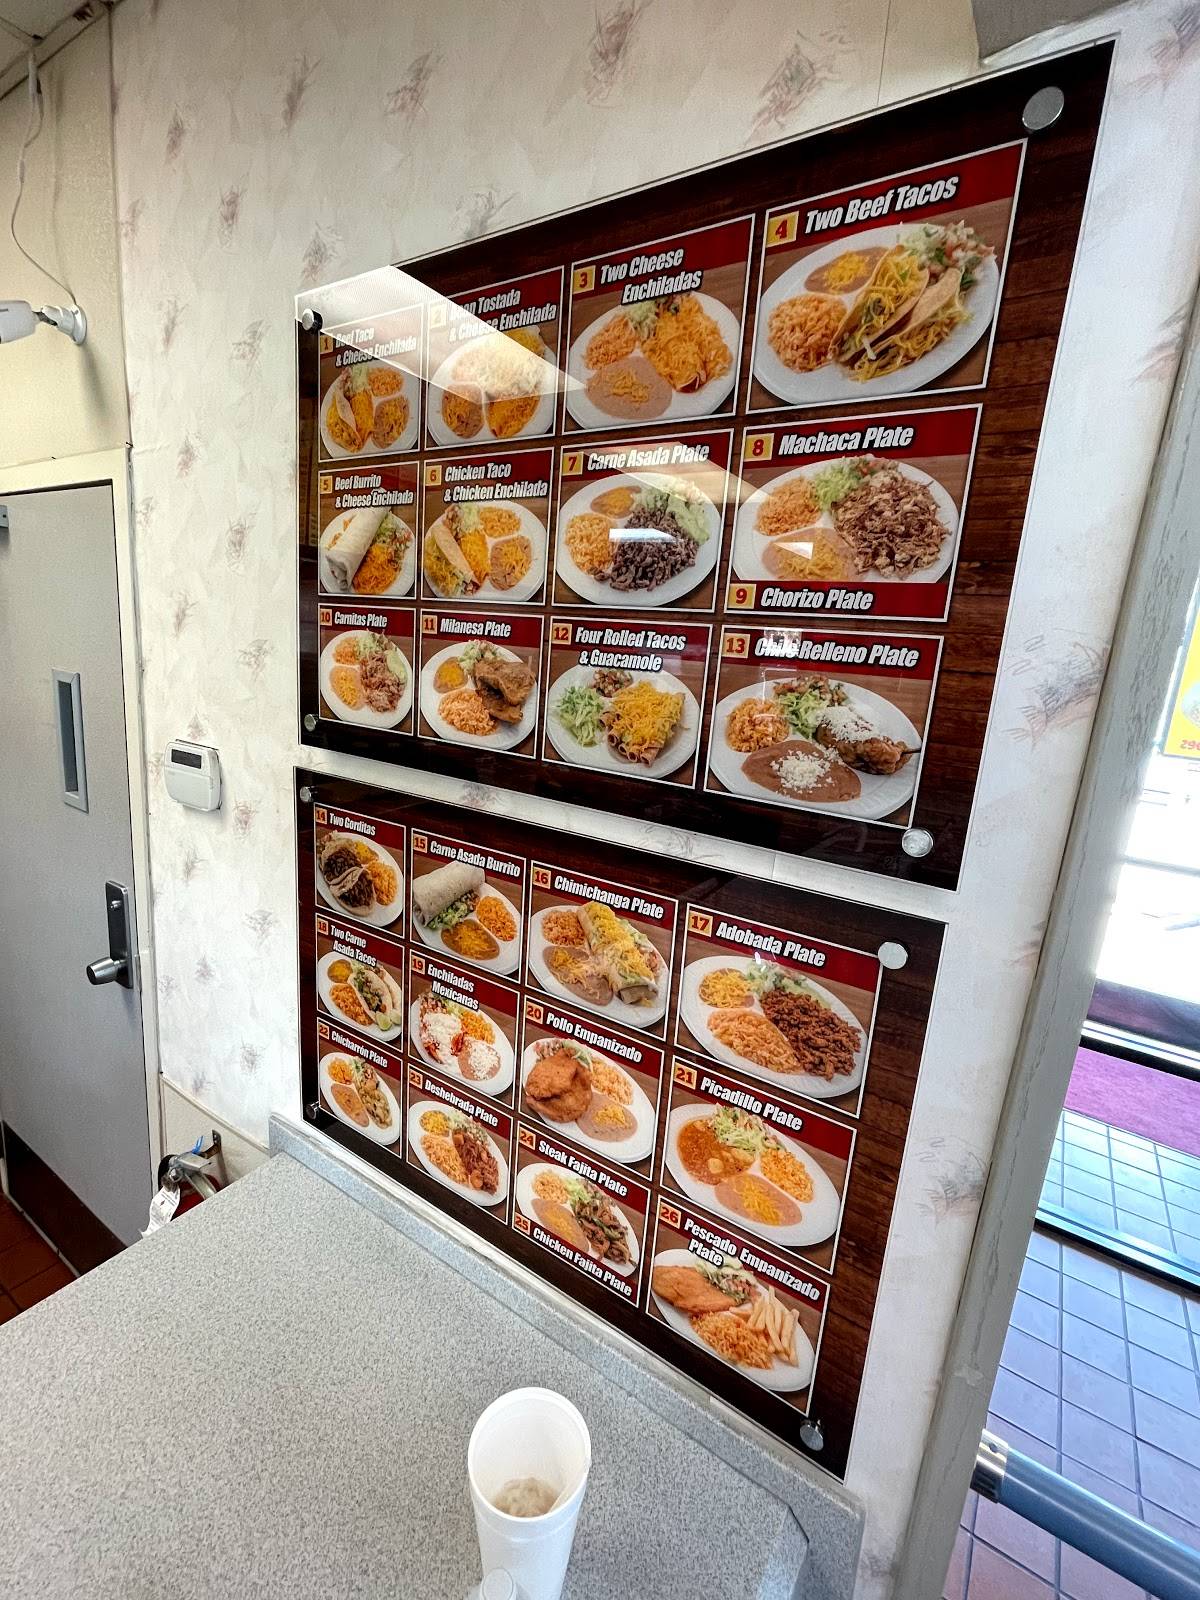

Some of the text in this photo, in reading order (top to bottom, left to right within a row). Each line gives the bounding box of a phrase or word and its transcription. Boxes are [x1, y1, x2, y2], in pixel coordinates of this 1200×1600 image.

[774, 175, 959, 240] 4 Two Beef Tacos
[578, 248, 684, 288] 3 Two Cheese
[478, 289, 521, 314] Tostada
[621, 270, 702, 304] Enchiladas
[500, 303, 556, 331] Enchilada
[335, 330, 354, 348] Beef
[355, 327, 375, 344] Taco
[335, 336, 417, 367] & Cheese Enchilada
[751, 425, 914, 456] 8 Machaca Plate
[429, 462, 512, 482] 6 Chicken Taco
[567, 444, 710, 472] 7 Carne Asada Plate
[322, 474, 381, 491] 5 Beef Burrito
[444, 480, 548, 502] & Chicken Enchilada
[335, 489, 414, 508] & Cheese Enchilada
[735, 587, 874, 610] 9 Chorizo Plate
[321, 611, 388, 628] 10 Carnitas Plate
[424, 618, 512, 637] 11 Milanesa Plate
[553, 626, 686, 650] 12 Four Rolled Tacos
[725, 637, 920, 668] 13 Chile Relleno Plate
[578, 649, 662, 671] & Guacamole
[317, 809, 376, 836] 14 Two Gorditas
[414, 836, 520, 878] 15 Carne Asada Burrito
[534, 871, 664, 919] 16 Chimichanga Plate
[330, 925, 345, 941] Two
[344, 930, 367, 948] Carne
[691, 914, 826, 967] 17 Adobada Plate
[333, 940, 377, 967] Asada Tacos
[413, 958, 474, 993] 19 Enchiladas
[432, 980, 478, 1010] Mexicanas
[319, 1024, 328, 1036] 22
[369, 1049, 388, 1068] Plate
[527, 1005, 642, 1063] 20 Pollo Empanizado
[410, 1071, 498, 1128] 23 Deshebrada Plate
[676, 1067, 803, 1131] 21 Picadillo Plate
[519, 1130, 628, 1197] 24 Steak Fajita Plate
[515, 1216, 633, 1296] 25 Chicken Fajita Plate
[660, 1205, 820, 1302] 26 Pescado Empanizado
[689, 1238, 723, 1266] Plate
